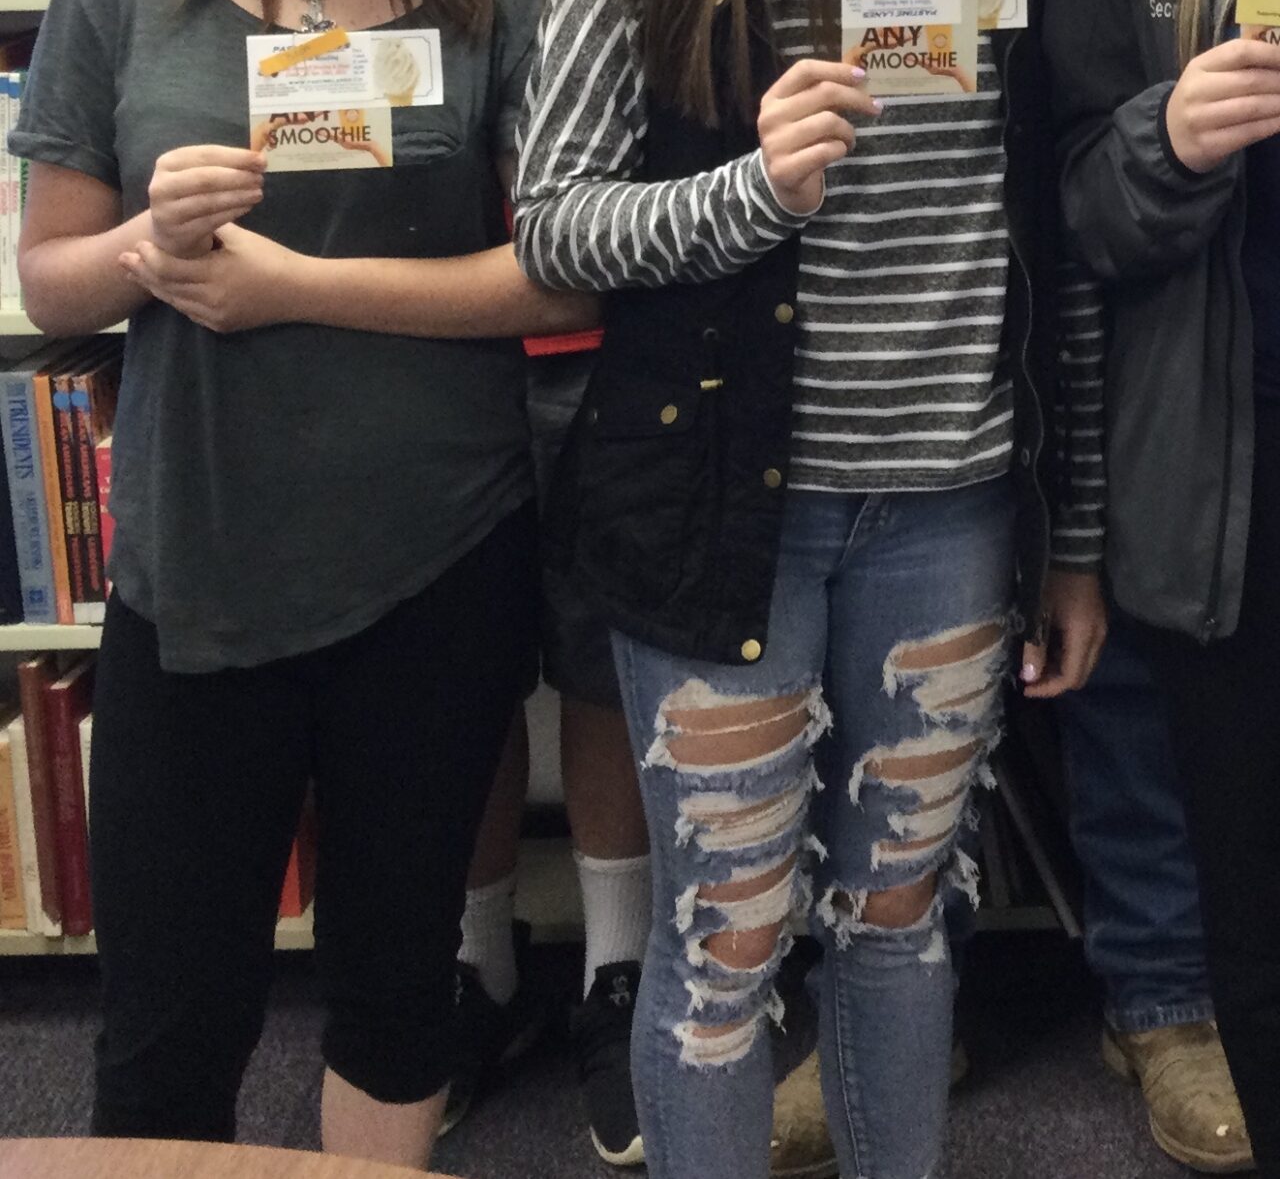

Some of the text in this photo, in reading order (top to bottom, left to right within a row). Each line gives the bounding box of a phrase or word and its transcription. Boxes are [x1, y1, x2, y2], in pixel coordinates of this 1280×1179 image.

[860, 24, 923, 48] ANY
[858, 51, 958, 70] SMOOTHIE
[268, 125, 372, 149] SMOOTHIE
